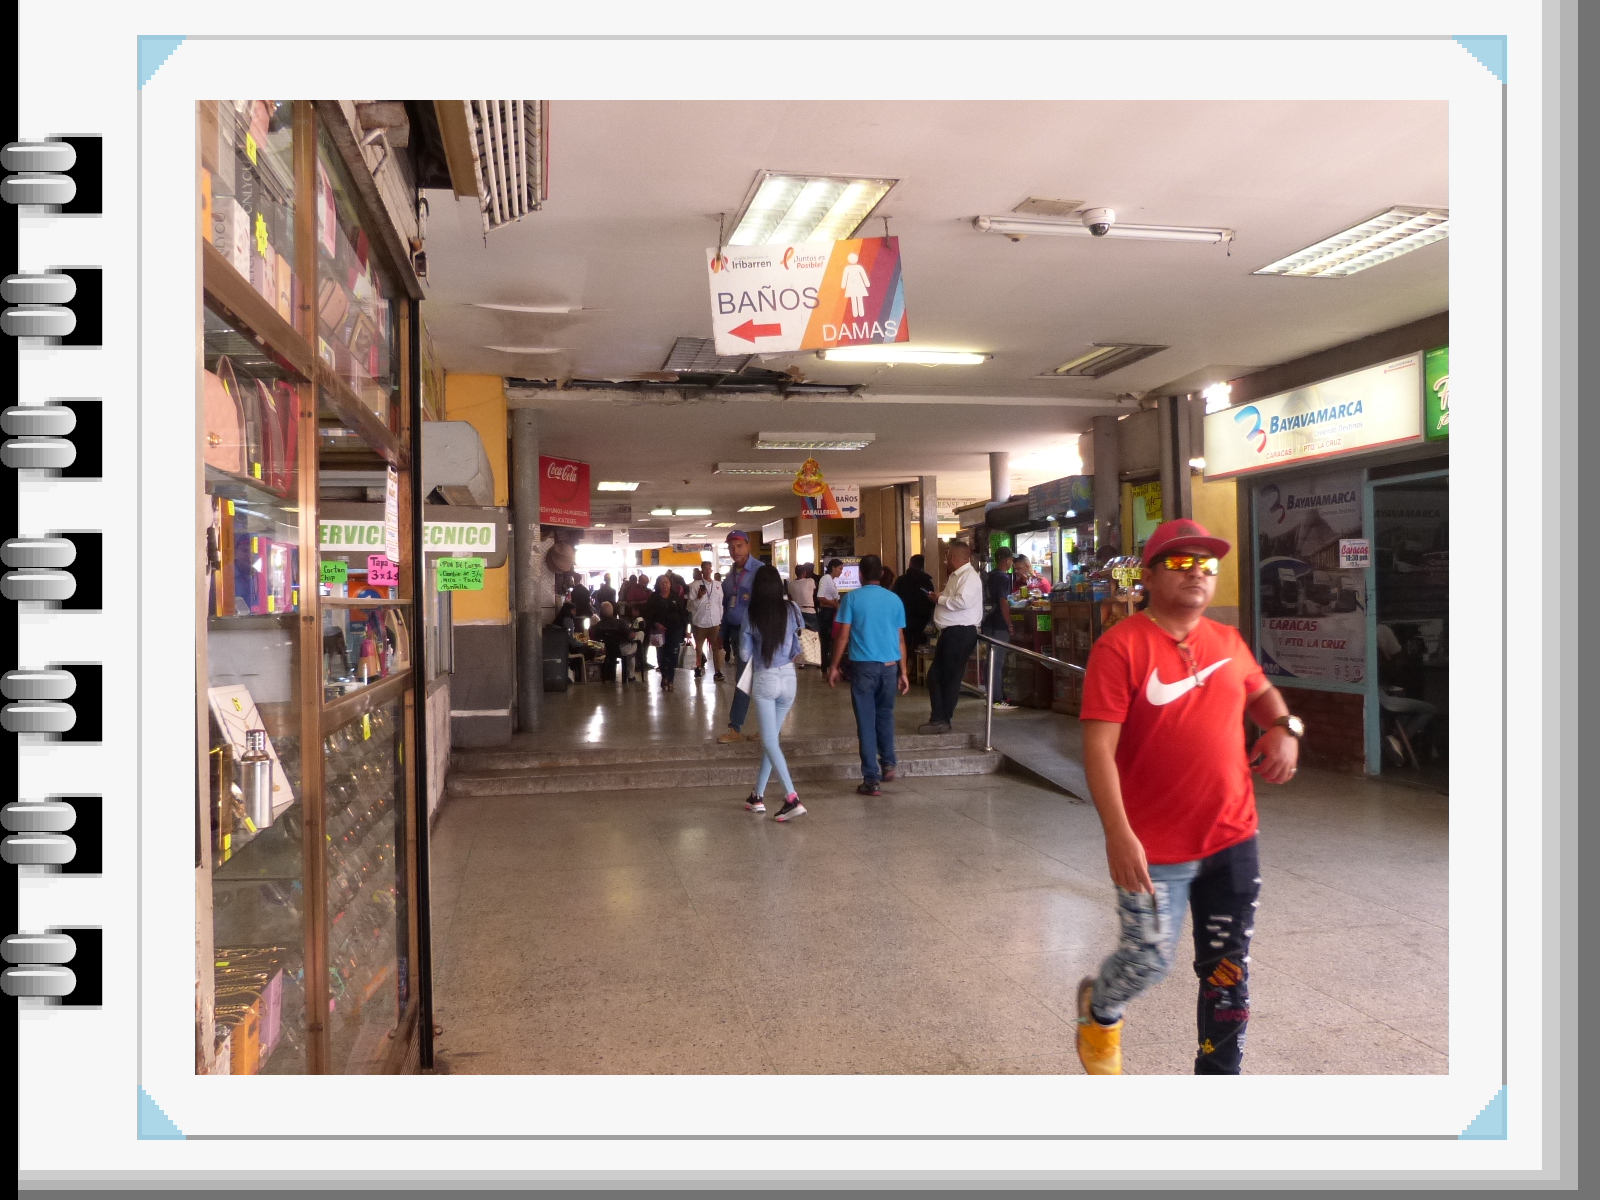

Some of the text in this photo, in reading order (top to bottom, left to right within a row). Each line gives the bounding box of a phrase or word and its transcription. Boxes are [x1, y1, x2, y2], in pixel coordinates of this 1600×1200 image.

[732, 260, 772, 270] Iribarren
[796, 261, 824, 270] Posible!
[717, 284, 820, 315] BAÑOS
[822, 320, 898, 342] DAMAS
[1269, 400, 1363, 435] BAYAVAMARCA
[1266, 448, 1293, 460] CARACAS
[1317, 441, 1325, 449] LA
[1325, 438, 1342, 448] CRUZ
[835, 495, 858, 503] BAÑOS
[937, 501, 960, 509] RENSE
[1287, 490, 1356, 510] BAYAVAMARCA
[424, 525, 492, 545] ECNICO
[369, 556, 389, 569] Tapa
[1268, 619, 1318, 631] CARACAS
[1307, 639, 1319, 648] LA
[1320, 639, 1347, 650] CRUZ
